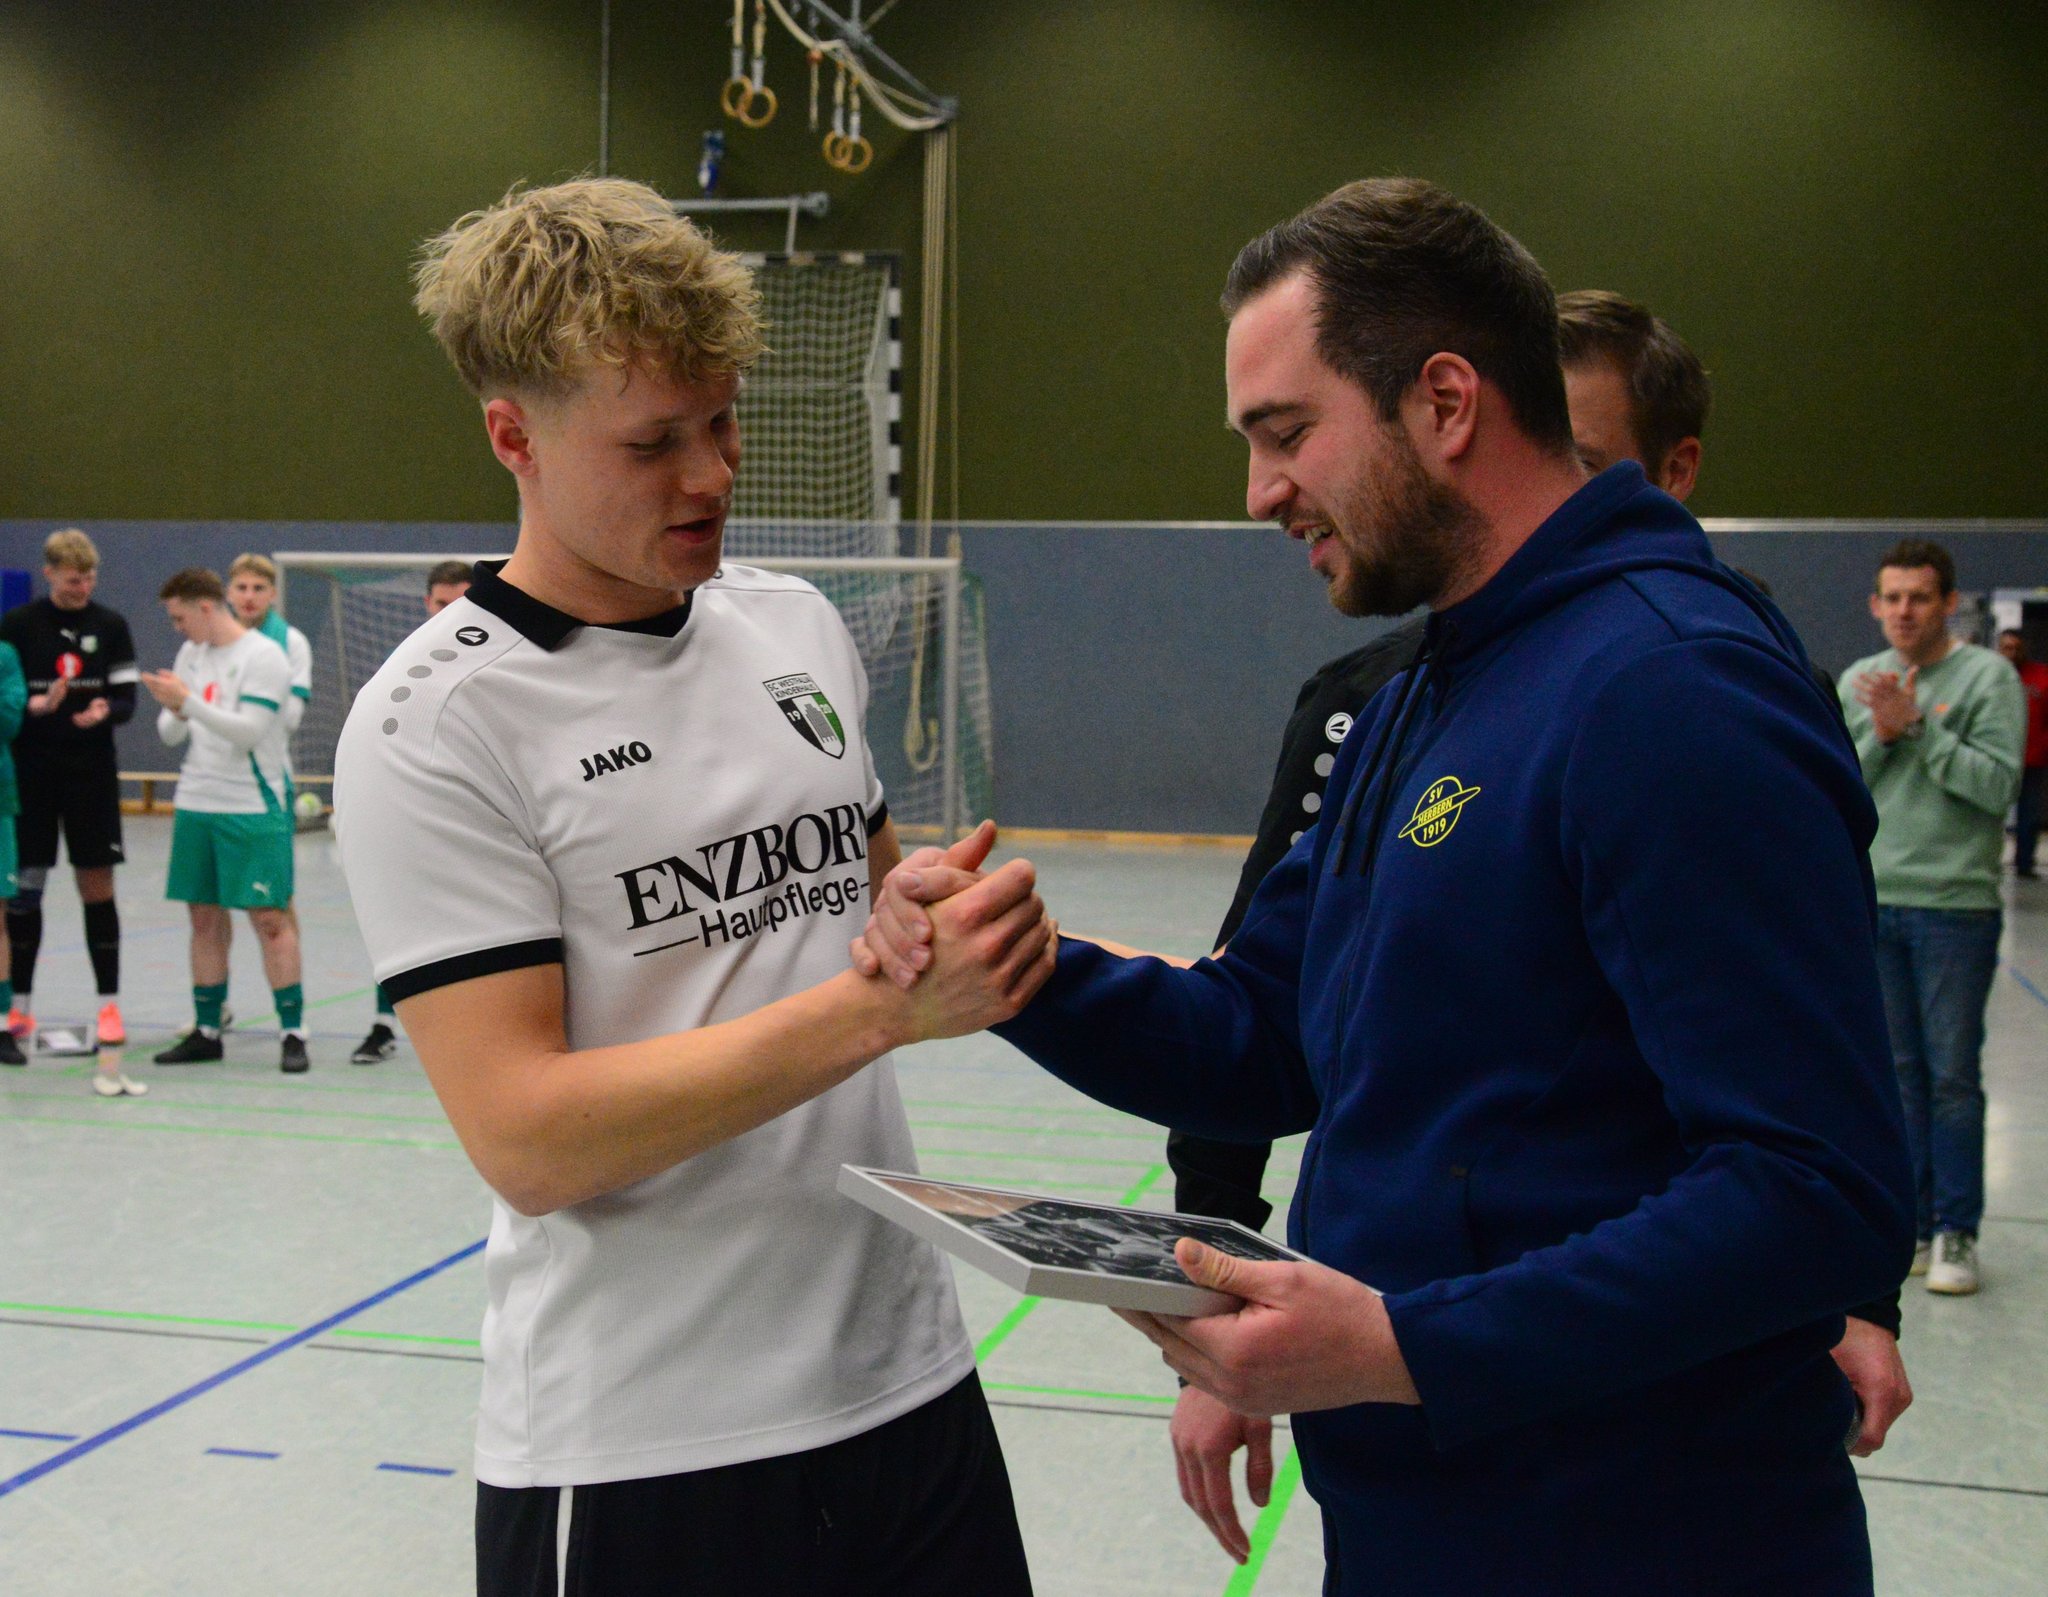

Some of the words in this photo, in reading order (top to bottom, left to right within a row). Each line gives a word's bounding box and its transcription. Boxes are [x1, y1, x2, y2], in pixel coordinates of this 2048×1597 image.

[786, 710, 801, 721] 19
[579, 740, 652, 782] JAKO
[1429, 785, 1443, 803] SV
[1423, 818, 1446, 841] 1919
[699, 876, 860, 948] Hautpflege
